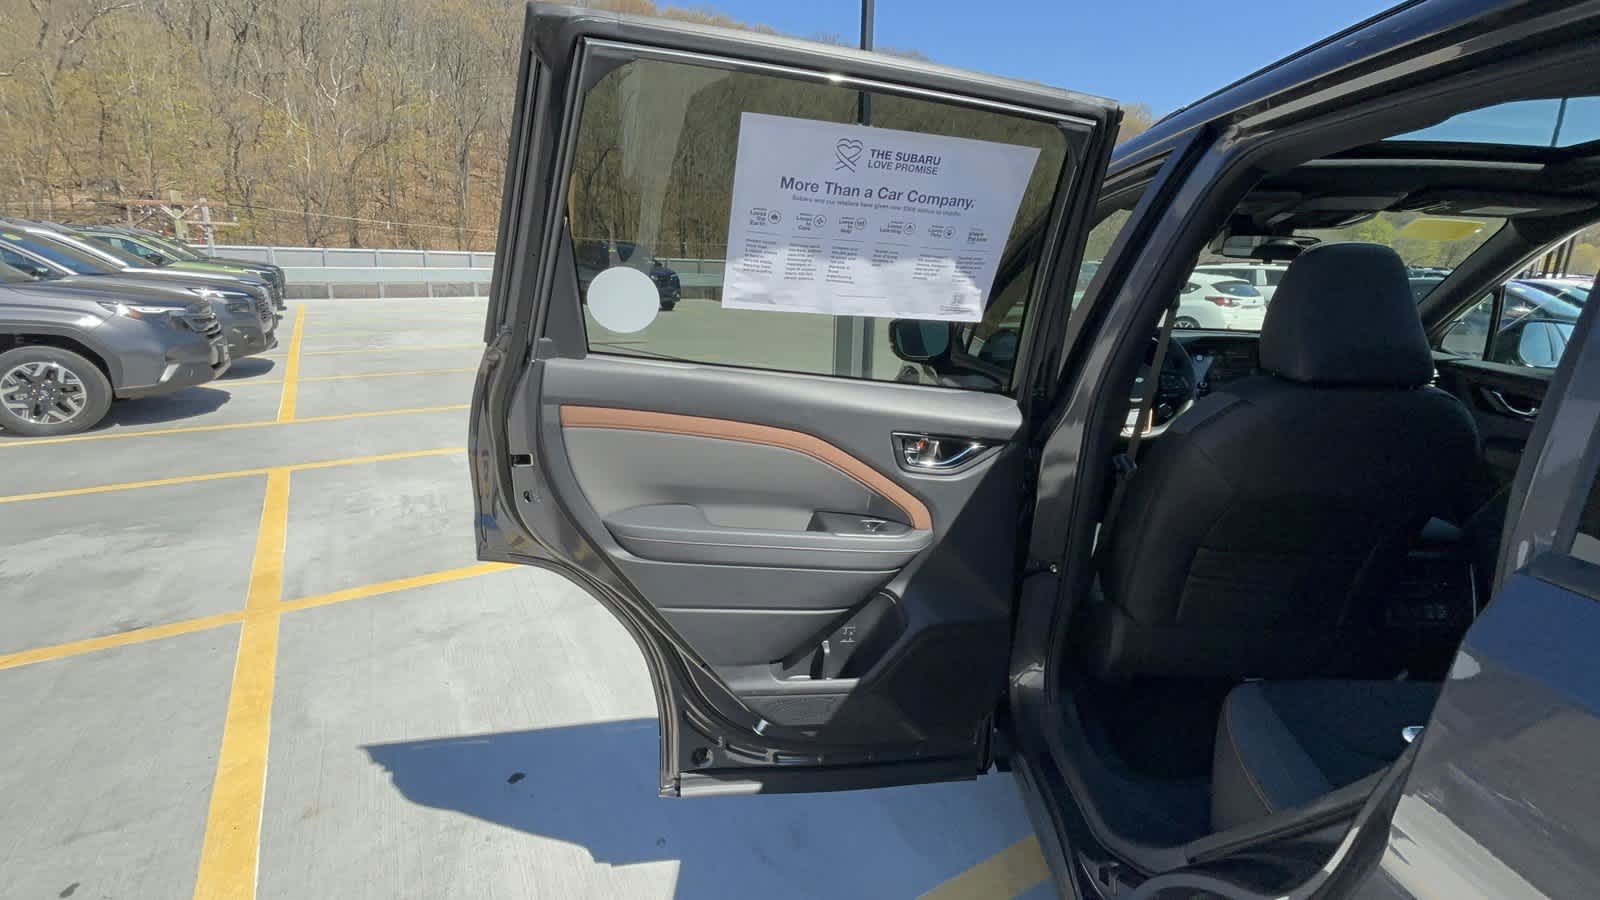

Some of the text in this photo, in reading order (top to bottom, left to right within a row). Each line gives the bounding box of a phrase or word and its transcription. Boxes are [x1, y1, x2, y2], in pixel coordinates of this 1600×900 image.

[870, 149, 942, 166] THE SUBARU
[868, 160, 939, 175] LOVE PROMISE
[780, 176, 976, 210] More Than a Car Company.
